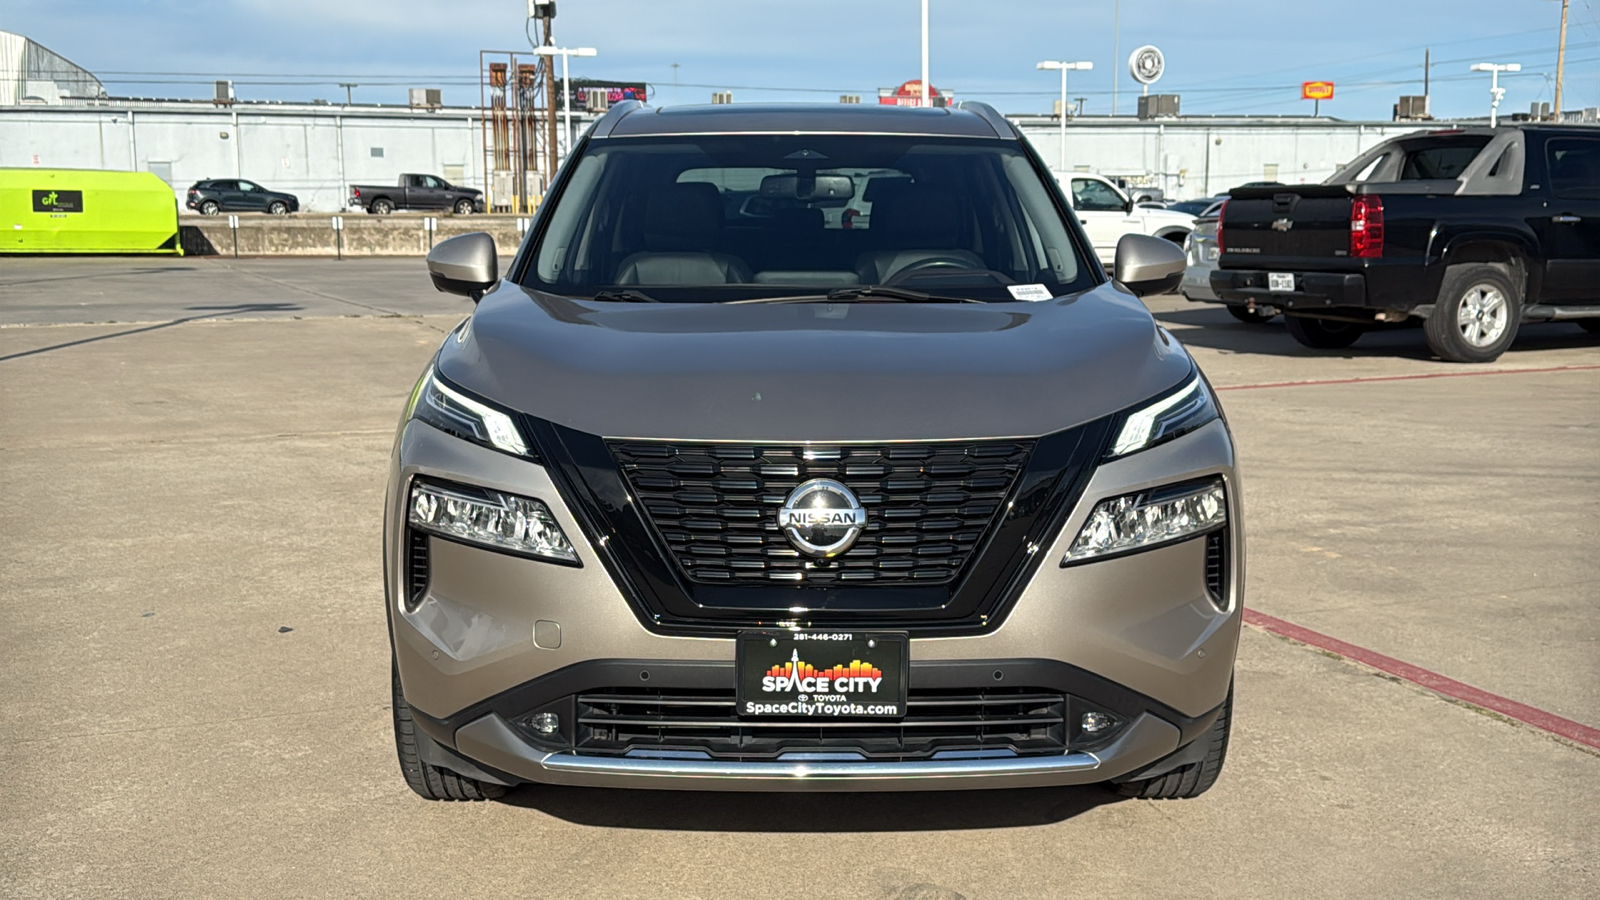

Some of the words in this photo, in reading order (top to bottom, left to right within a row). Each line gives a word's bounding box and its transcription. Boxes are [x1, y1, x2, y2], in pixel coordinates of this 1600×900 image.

[789, 513, 856, 523] NISSAN
[793, 633, 853, 641] 281-446-0271
[762, 676, 829, 693] SPACE
[834, 677, 882, 693] CITY
[746, 702, 897, 715] SpaceCityToyota.com
